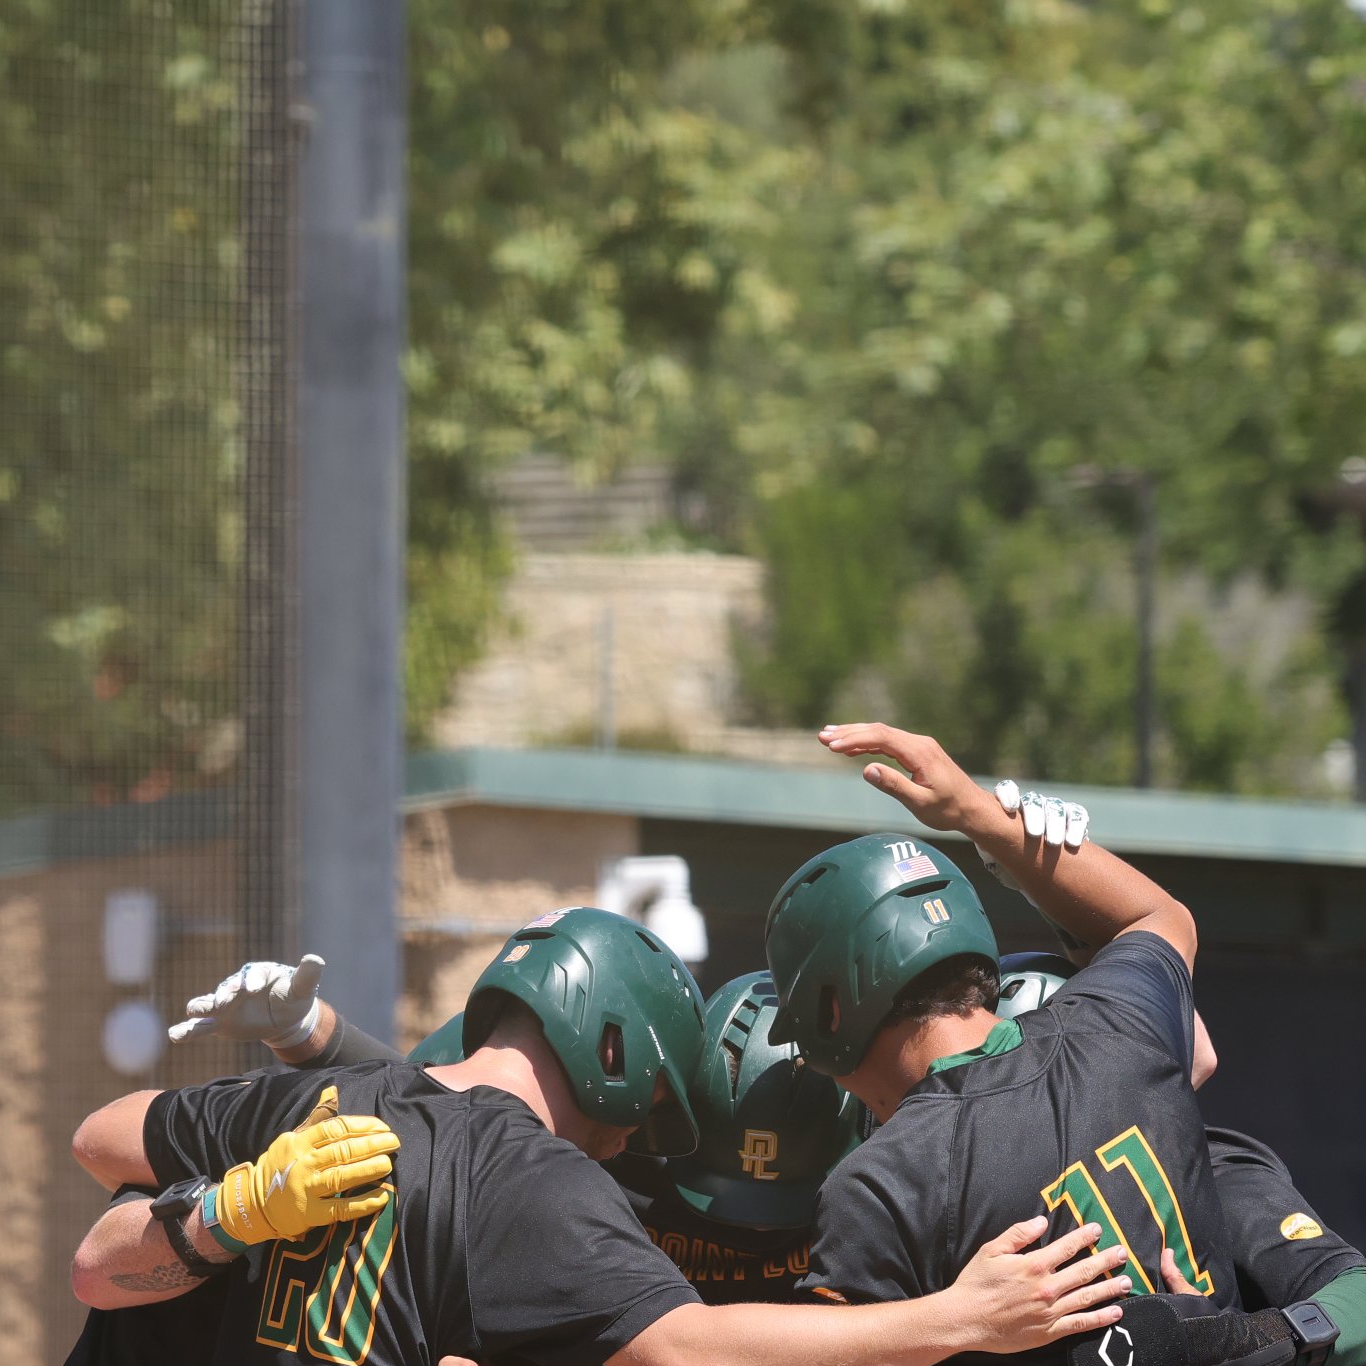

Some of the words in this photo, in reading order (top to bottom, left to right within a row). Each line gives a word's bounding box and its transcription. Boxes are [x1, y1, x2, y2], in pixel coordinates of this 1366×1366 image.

[502, 944, 530, 963] 20
[923, 899, 950, 924] 11
[1040, 1124, 1215, 1298] 11
[256, 1182, 399, 1366] 20
